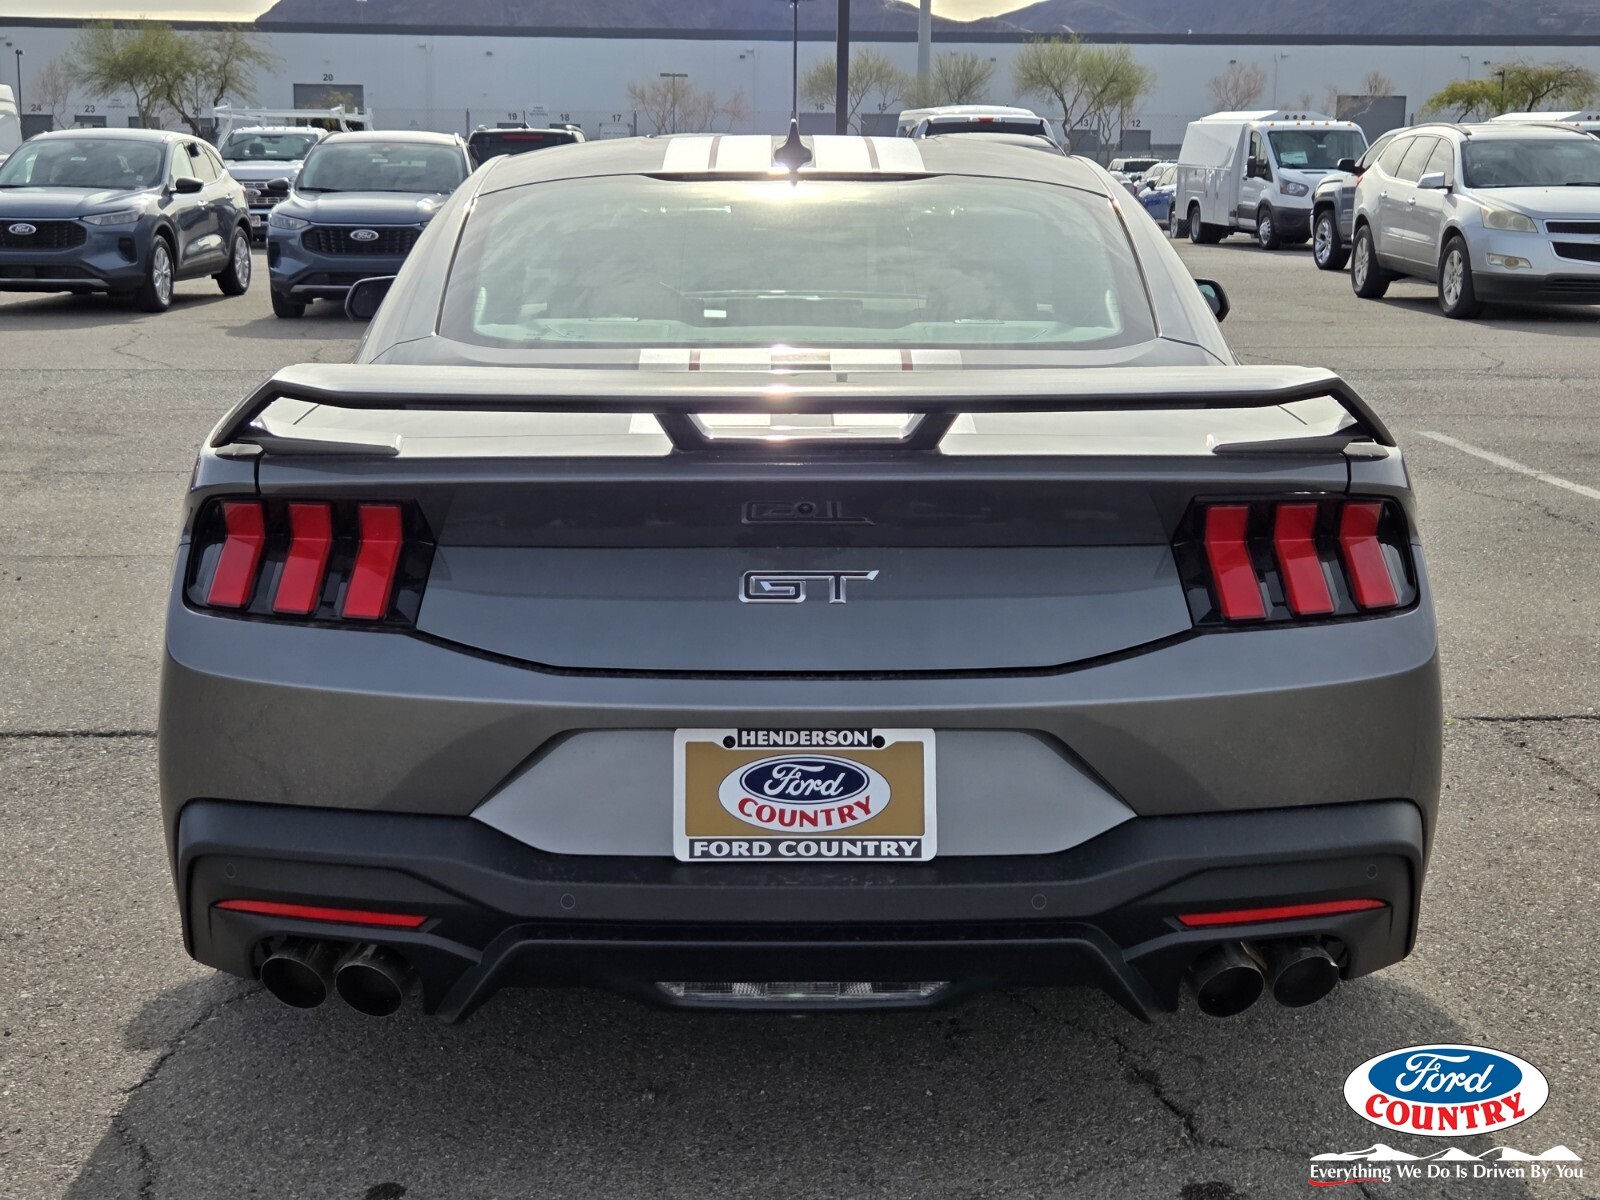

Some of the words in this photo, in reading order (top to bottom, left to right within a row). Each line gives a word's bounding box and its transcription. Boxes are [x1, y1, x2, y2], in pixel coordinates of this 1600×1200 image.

[322, 73, 334, 82] 20
[31, 103, 42, 112] 24
[84, 104, 96, 113] 23
[815, 103, 825, 111] 16
[507, 112, 518, 121] 19
[560, 113, 570, 122] 18
[612, 114, 622, 122] 17
[1131, 119, 1141, 128] 12
[738, 570, 880, 604] GT
[741, 730, 868, 746] HENDERSON
[763, 763, 846, 796] Ford
[738, 795, 873, 828] COUNTRY
[693, 841, 772, 857] FORD
[778, 841, 918, 857] COUNTRY
